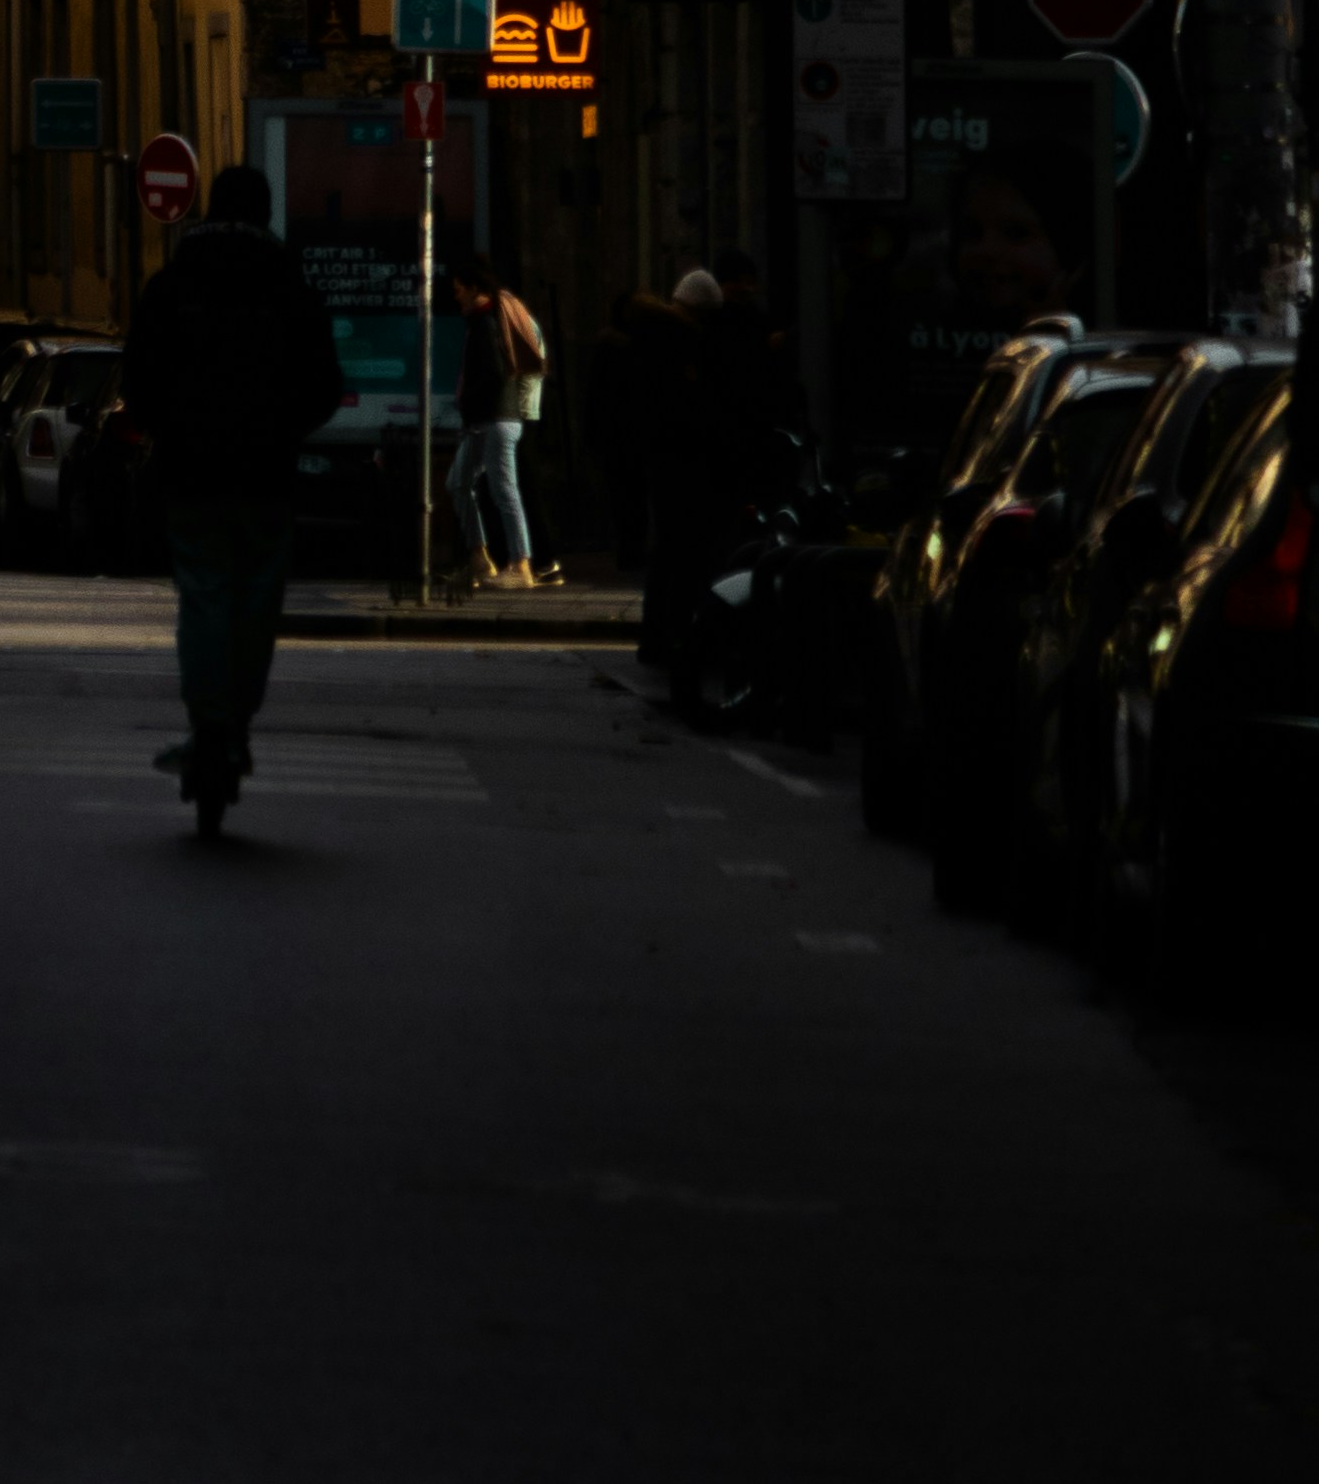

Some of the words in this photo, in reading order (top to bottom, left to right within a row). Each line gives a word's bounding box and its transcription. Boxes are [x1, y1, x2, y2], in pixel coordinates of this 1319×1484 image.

[486, 74, 595, 90] BIOBURGER
[323, 263, 349, 275] LOI
[316, 279, 388, 292] COMPTER
[324, 294, 385, 307] JANVIER
